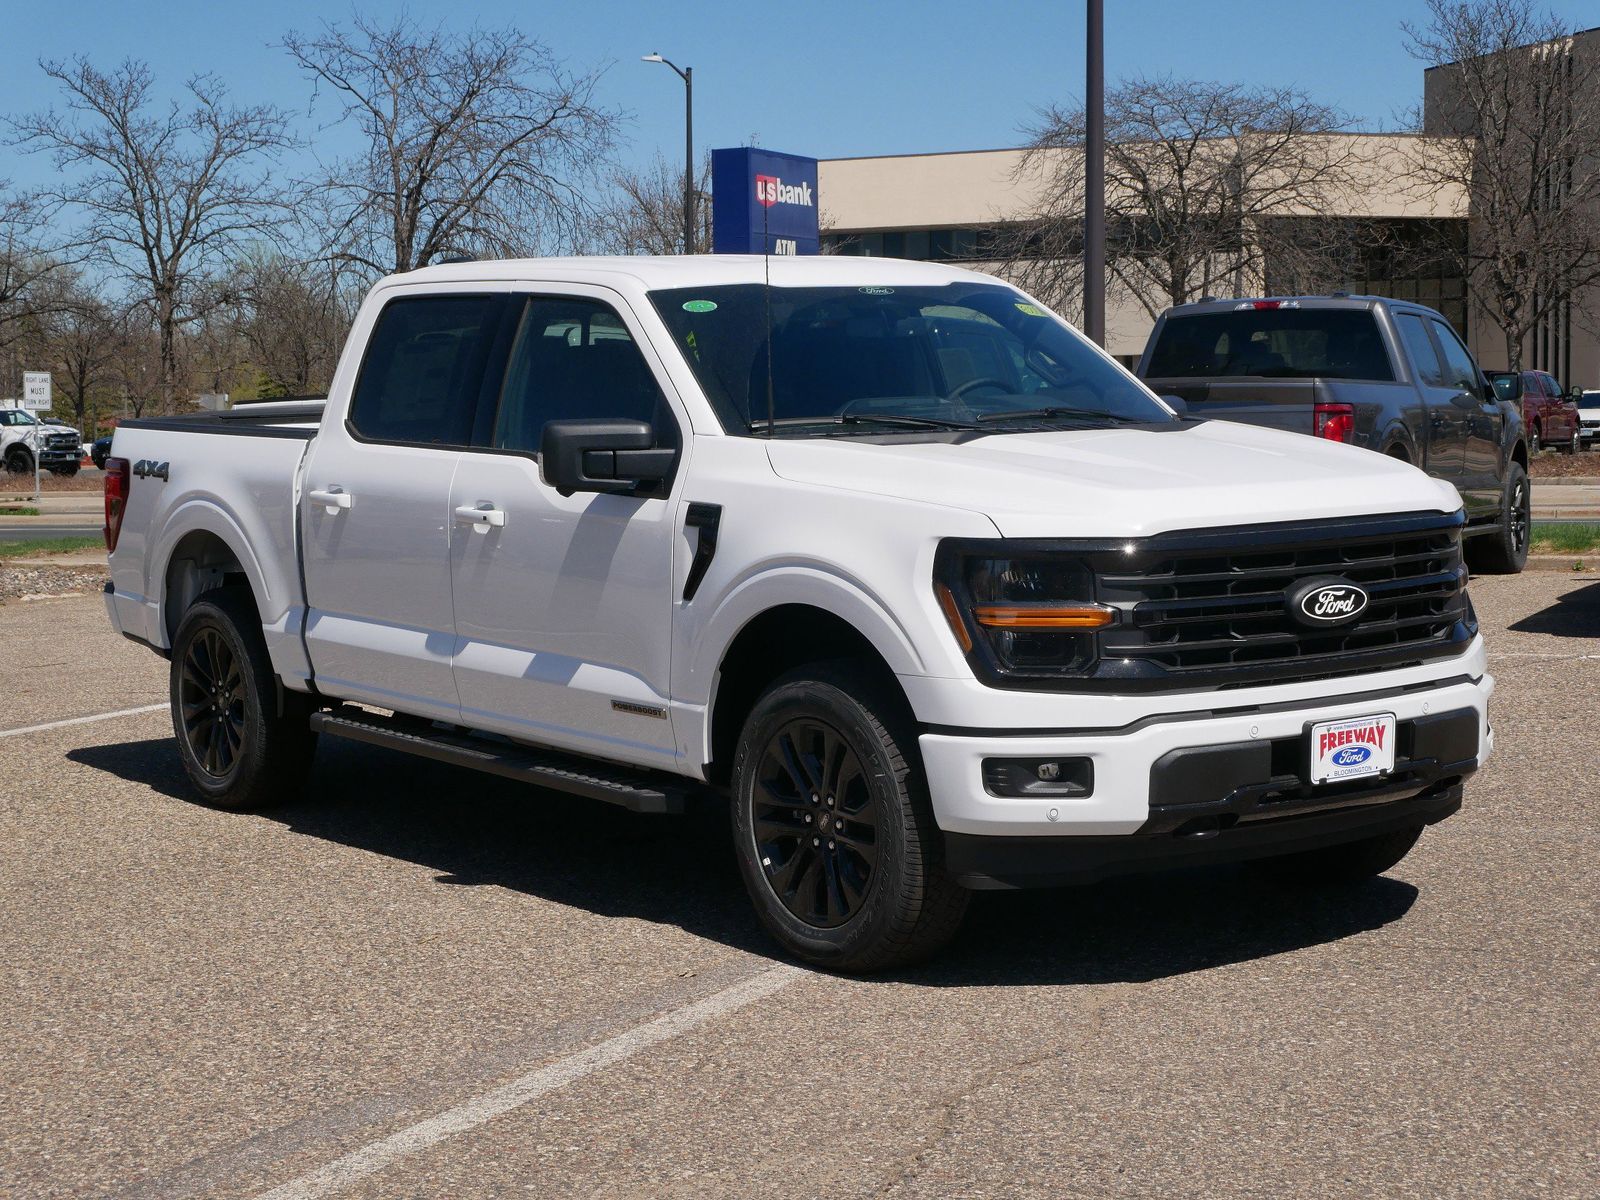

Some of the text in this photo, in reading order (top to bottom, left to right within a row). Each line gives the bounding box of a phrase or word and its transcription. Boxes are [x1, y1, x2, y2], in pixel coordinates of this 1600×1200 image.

[775, 239, 797, 256] ATM
[1315, 590, 1356, 615] Ford
[1319, 725, 1386, 763] FREEWAY
[1338, 749, 1364, 764] Ford
[1334, 766, 1372, 776] BLOOMINGTON
